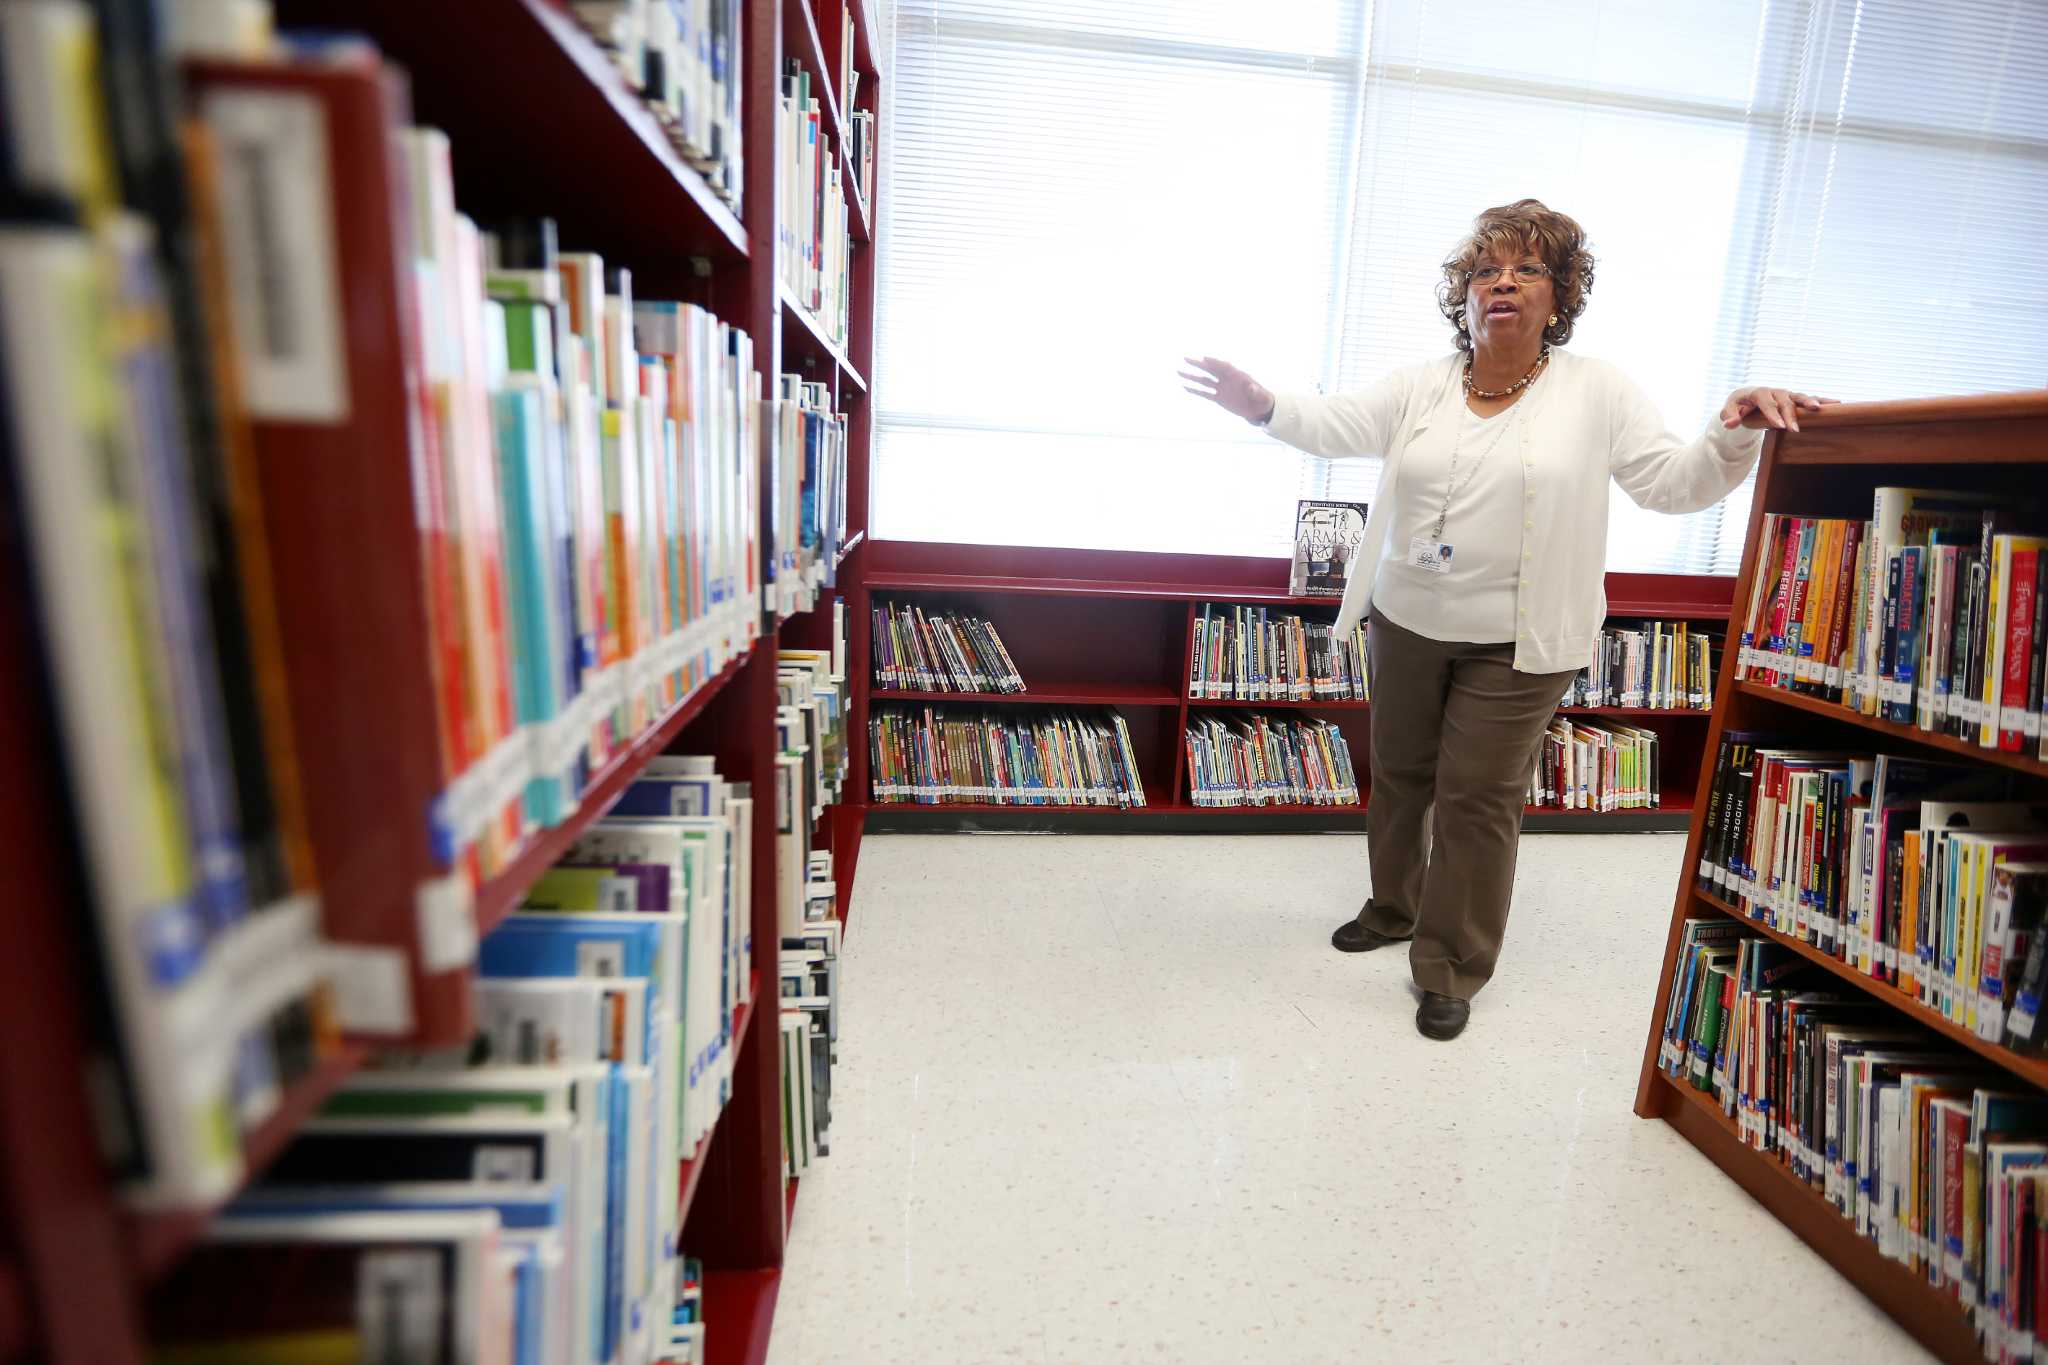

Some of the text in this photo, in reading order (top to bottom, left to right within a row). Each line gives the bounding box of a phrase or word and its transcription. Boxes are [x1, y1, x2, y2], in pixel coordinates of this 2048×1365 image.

[1300, 529, 1361, 545] ARMS &
[1776, 570, 1791, 609] REBELS
[1790, 580, 1804, 621] Pathfinders
[1899, 555, 1916, 631] RADIOACTIVE
[1722, 792, 1734, 832] HIDDEN
[1732, 799, 1744, 840] HIDDEN
